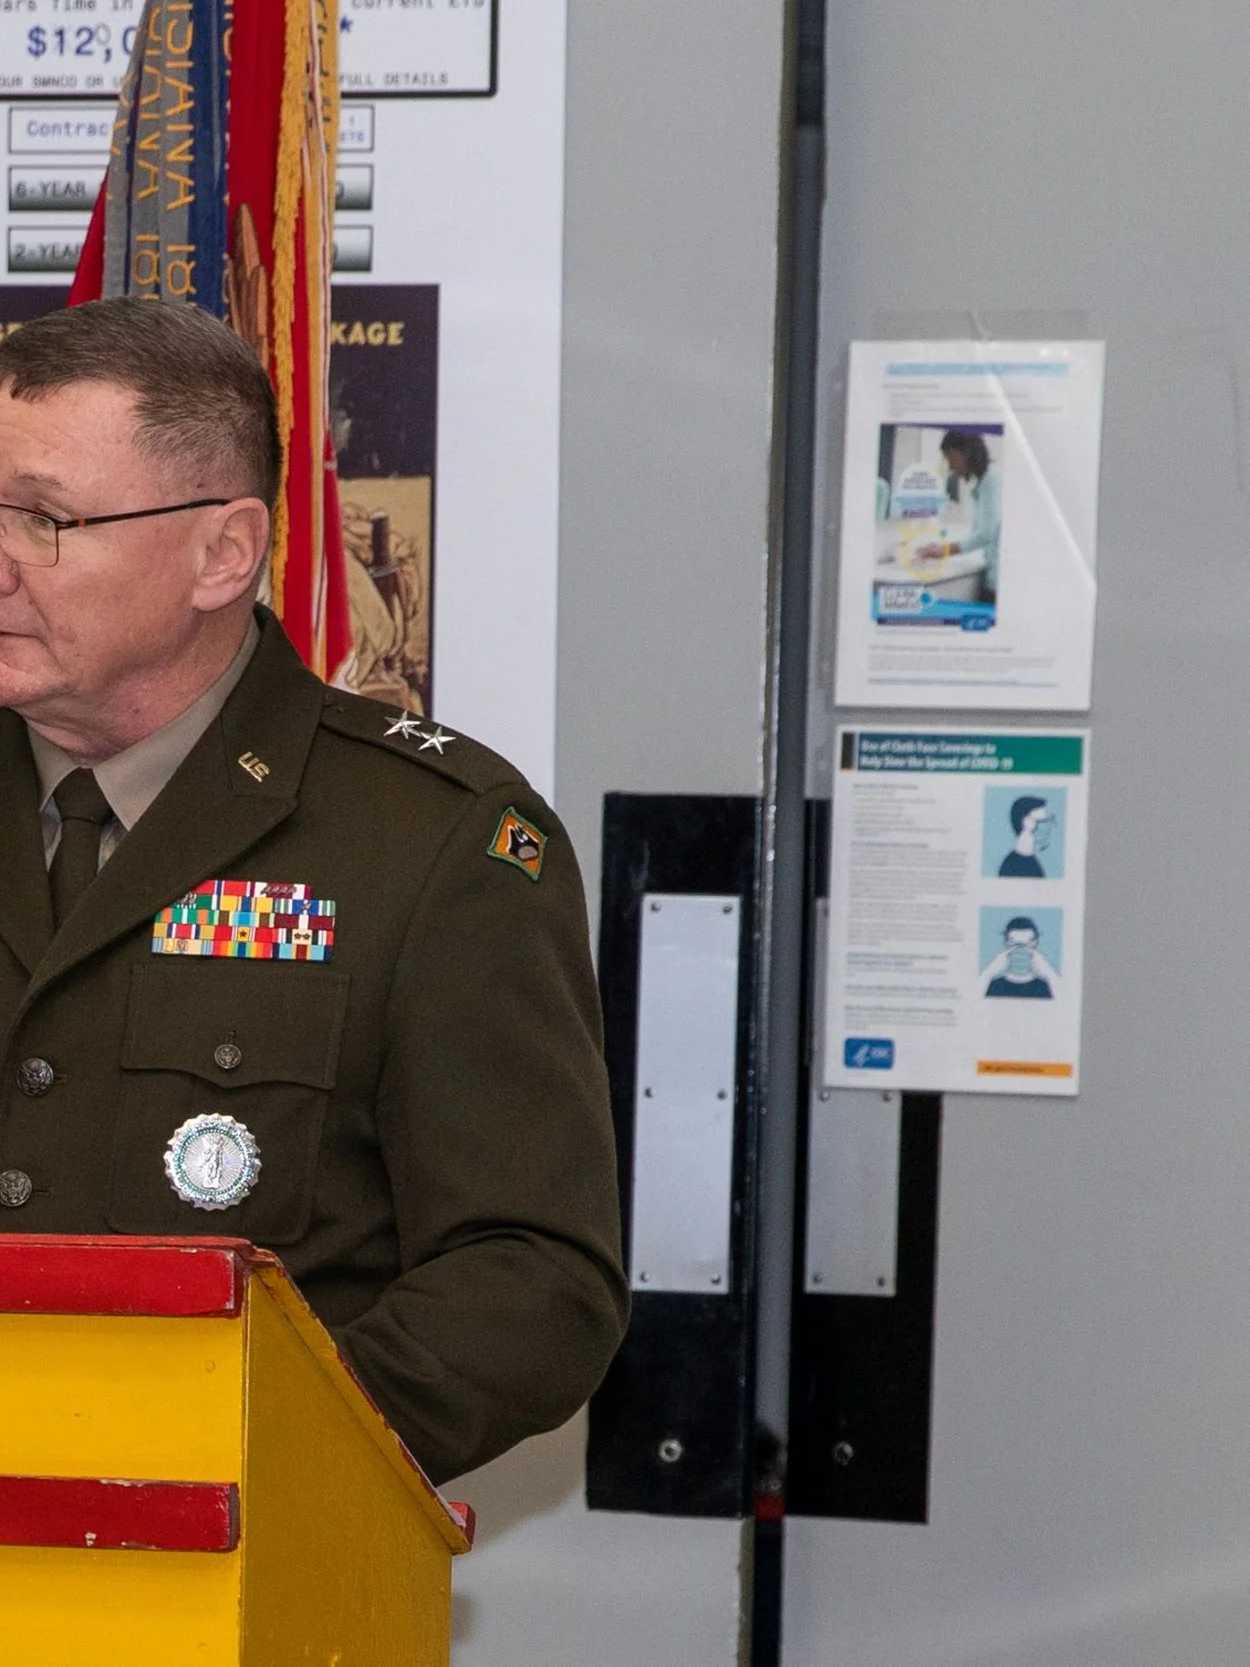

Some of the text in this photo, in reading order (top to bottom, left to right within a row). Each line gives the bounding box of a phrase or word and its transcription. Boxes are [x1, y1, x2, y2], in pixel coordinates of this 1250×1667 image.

[27, 25, 138, 63] $12,0
[27, 120, 109, 137] Contrac
[15, 241, 80, 260] 2-YEA
[330, 320, 405, 345] KAGE
